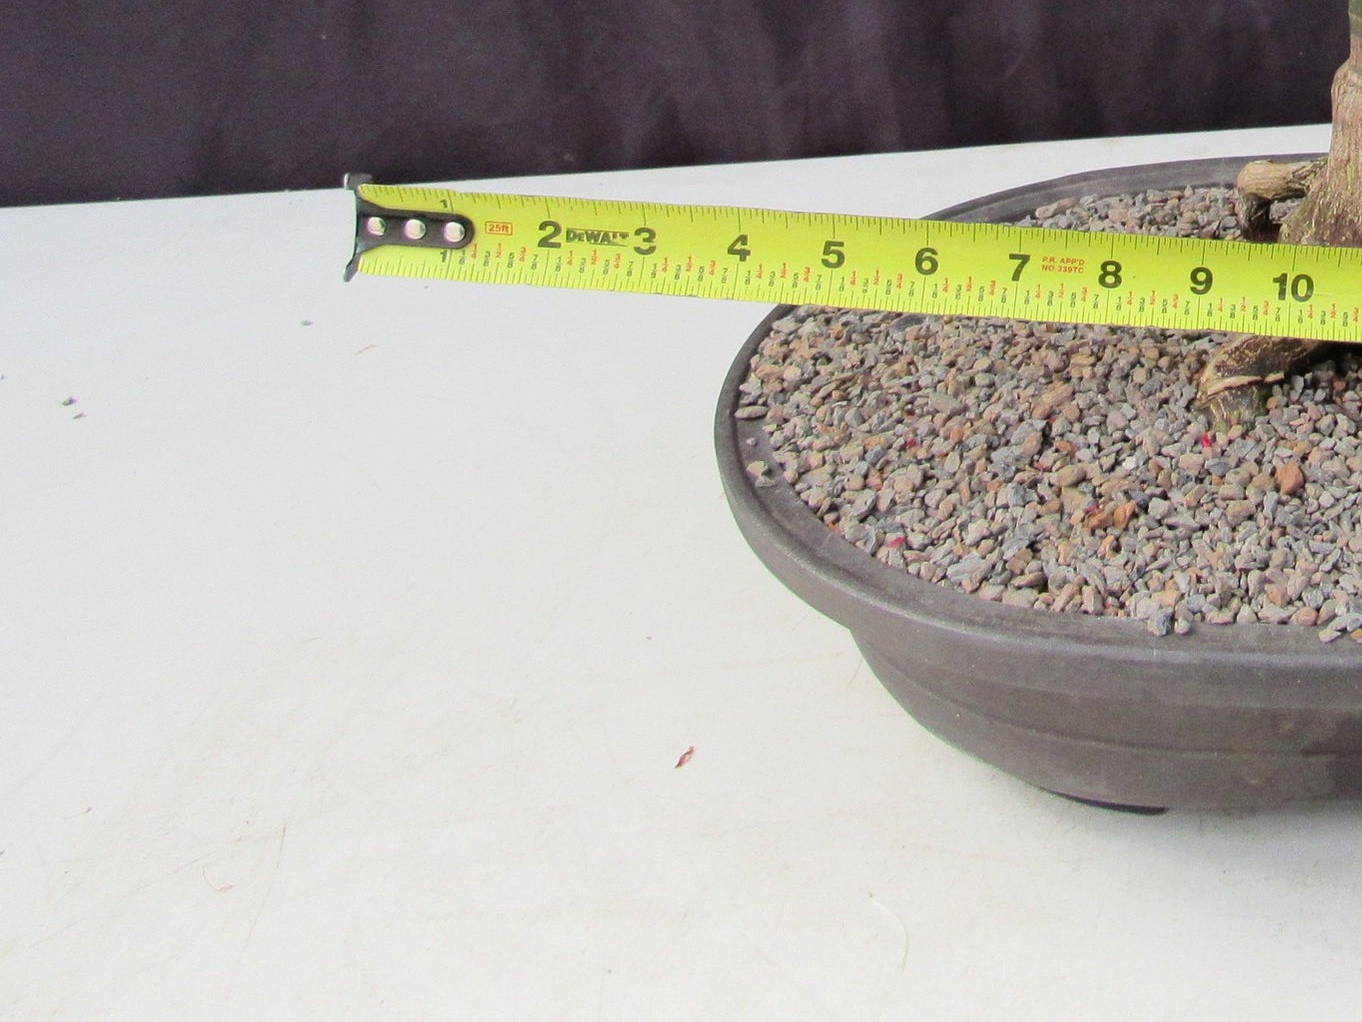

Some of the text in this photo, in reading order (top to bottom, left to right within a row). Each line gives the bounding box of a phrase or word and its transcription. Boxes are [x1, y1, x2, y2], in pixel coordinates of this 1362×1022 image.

[488, 223, 509, 233] 25ft
[537, 220, 562, 249] 2
[633, 227, 657, 256] 3
[727, 234, 751, 262] 4
[821, 240, 846, 269] 5
[914, 247, 939, 276] 6
[1008, 253, 1031, 282] 7
[1097, 260, 1123, 289] 8
[1189, 266, 1214, 295] 9
[1272, 272, 1314, 303] 10
